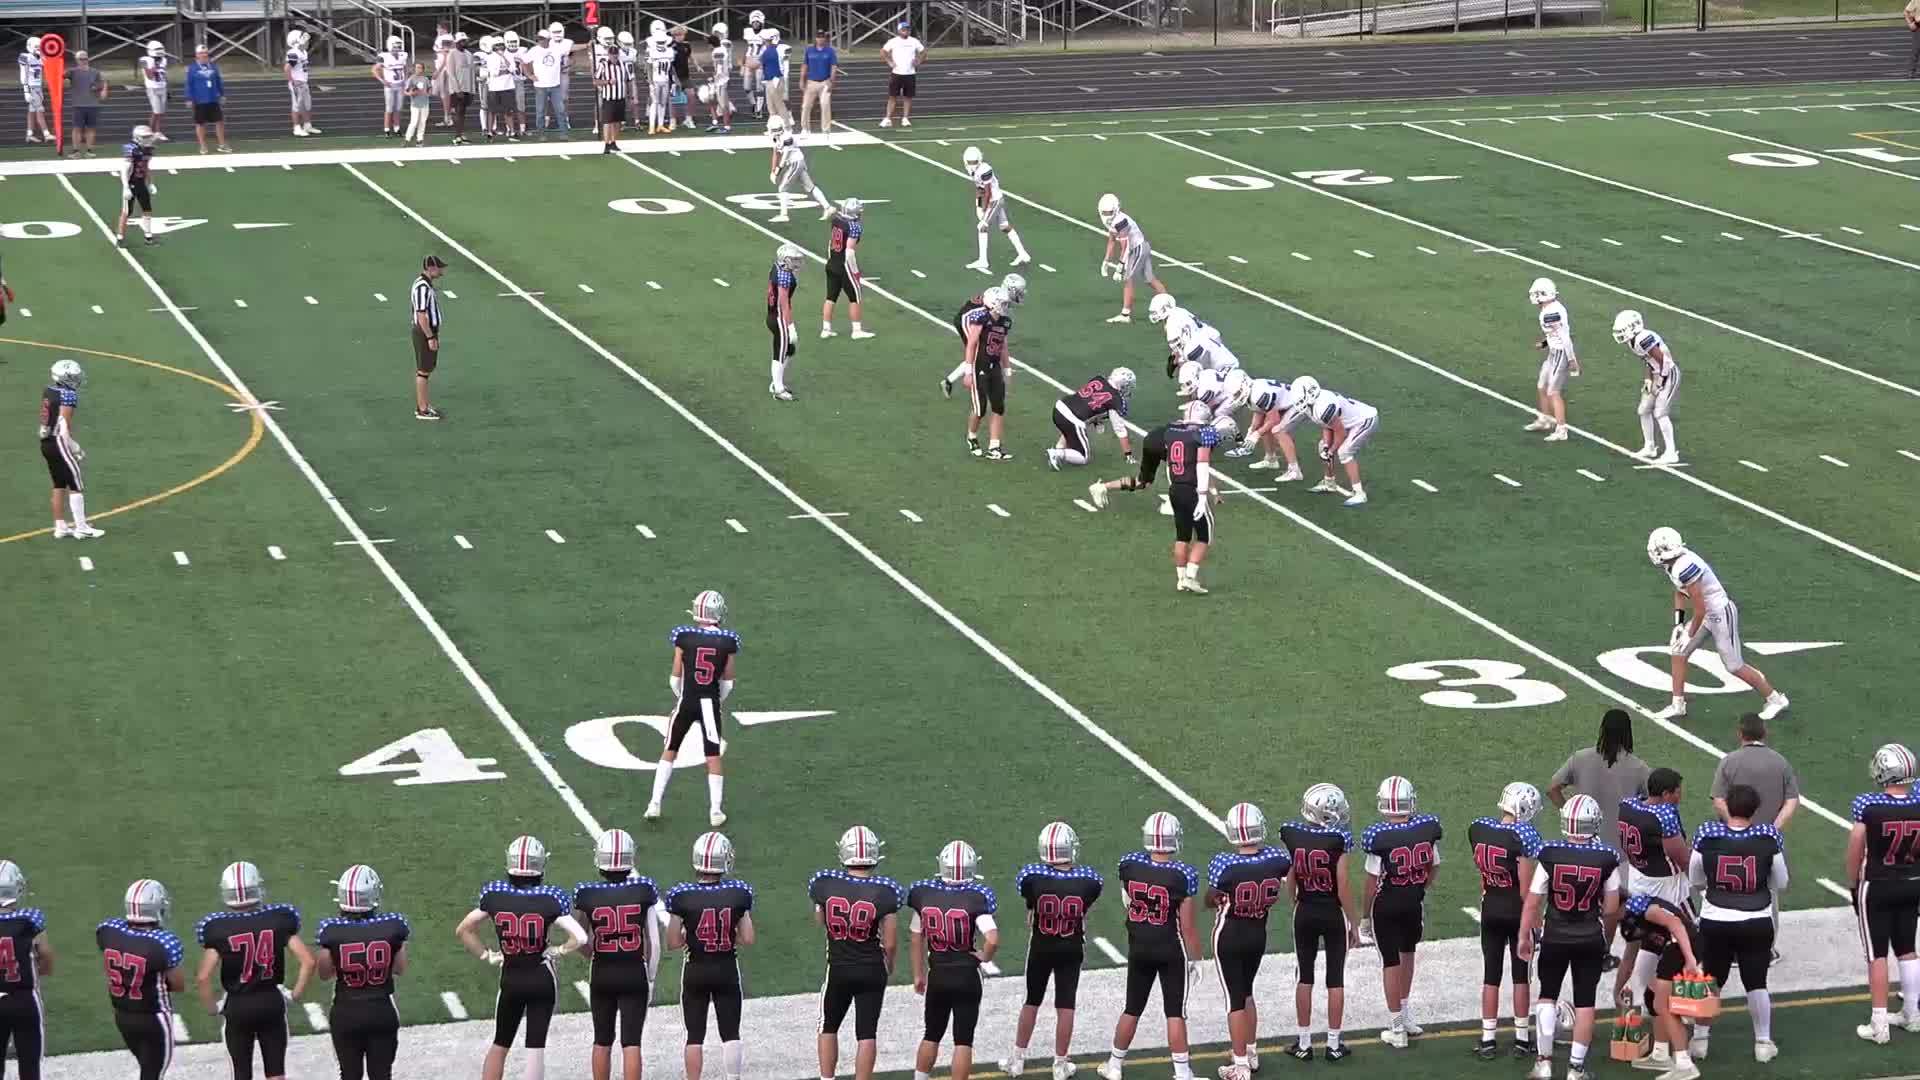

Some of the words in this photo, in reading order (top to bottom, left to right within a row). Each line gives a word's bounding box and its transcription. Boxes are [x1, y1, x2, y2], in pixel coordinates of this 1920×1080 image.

[585, 2, 598, 24] 2
[1079, 380, 1113, 411] 64
[1170, 441, 1184, 475] 9
[696, 647, 717, 685] 5
[1882, 820, 1920, 865] 77
[1552, 863, 1601, 911] 57
[1716, 855, 1757, 893] 51
[825, 896, 877, 941] 68
[1037, 894, 1084, 937] 88
[1128, 880, 1169, 925] 53
[495, 911, 545, 954] 30
[592, 904, 641, 952] 25
[696, 907, 732, 952] 41
[921, 906, 970, 952] 80
[104, 948, 147, 1000] 67
[229, 930, 275, 983] 74
[339, 941, 392, 988] 58
